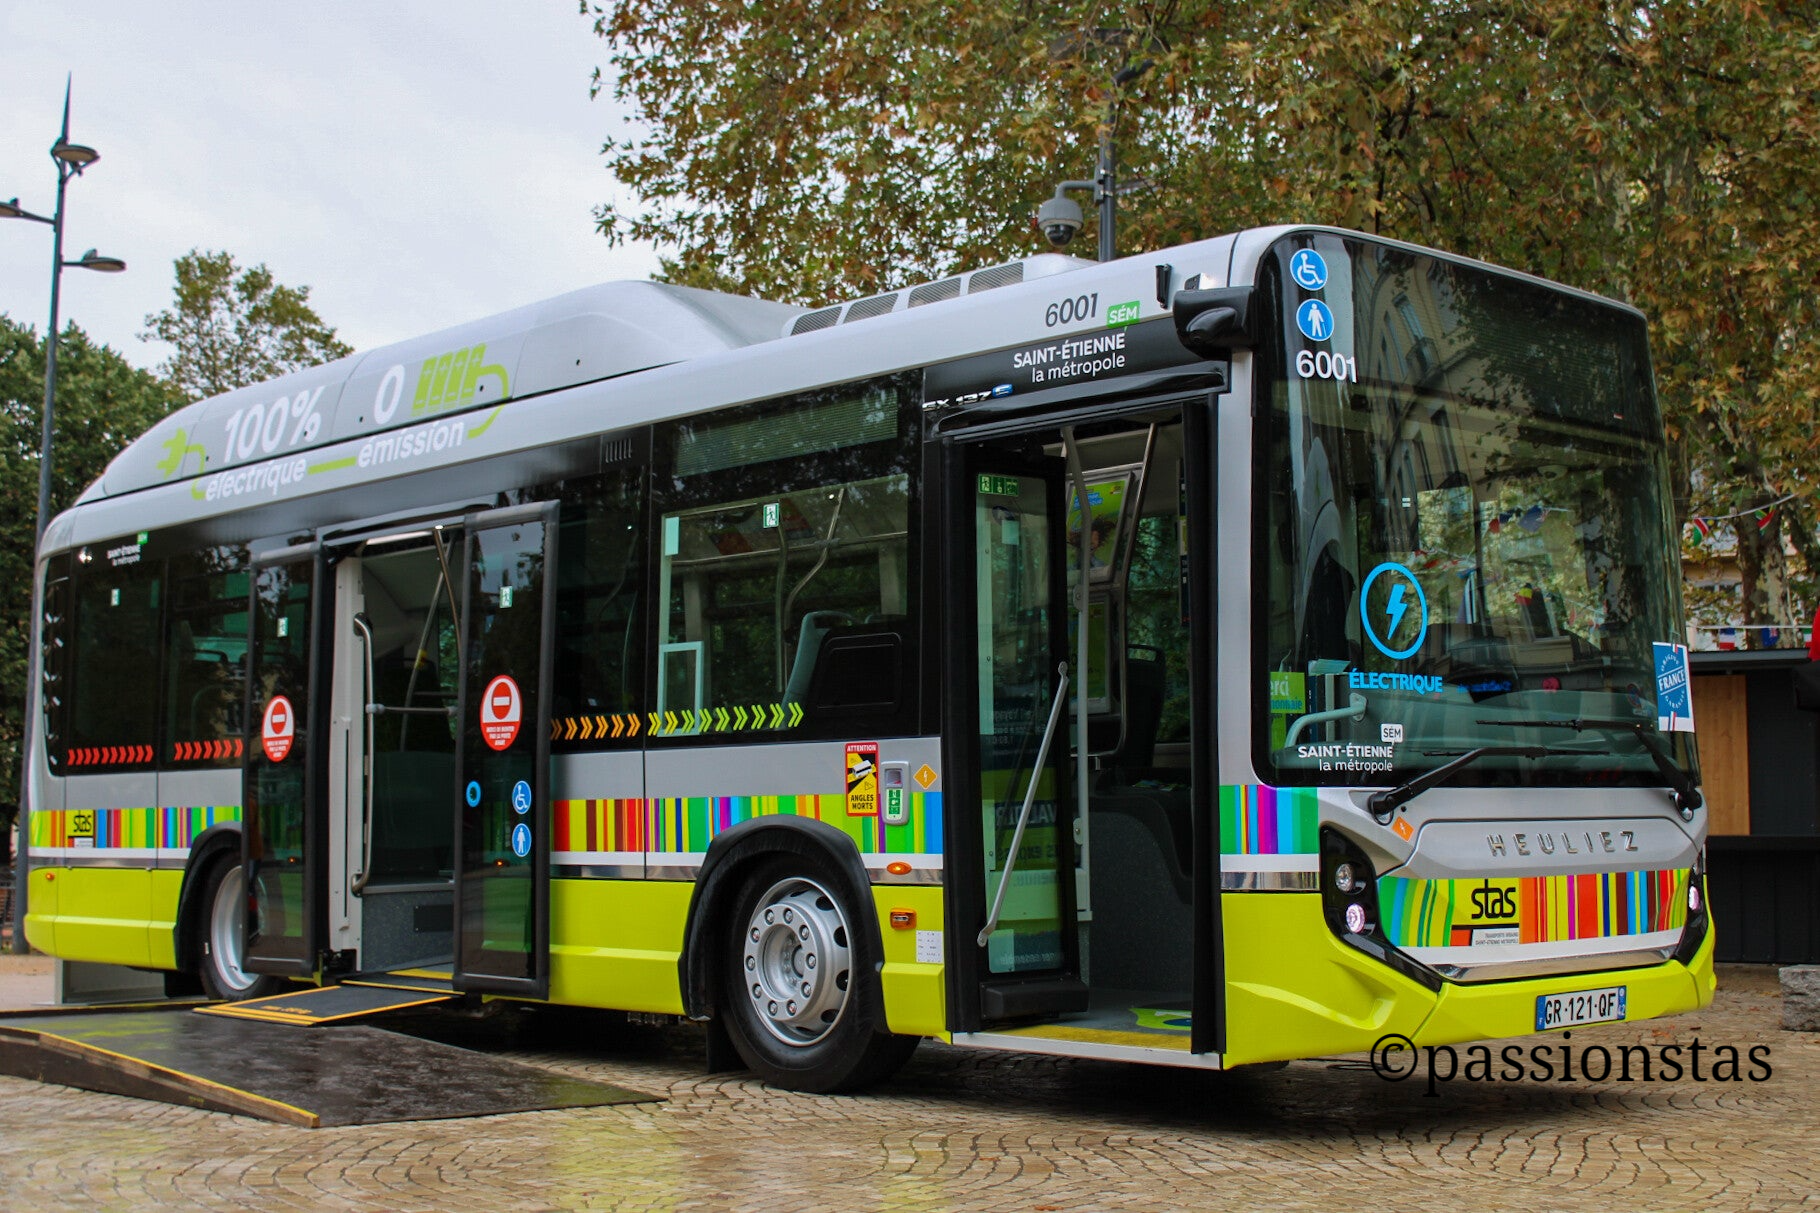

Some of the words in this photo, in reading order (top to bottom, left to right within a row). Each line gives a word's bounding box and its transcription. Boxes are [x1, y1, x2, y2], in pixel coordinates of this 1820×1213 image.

[1045, 292, 1098, 327] 6001
[1109, 304, 1138, 324] SÉM
[1013, 332, 1126, 369] SAINT-ÉTIENNE
[1031, 367, 1045, 383] la
[1047, 352, 1126, 380] métropole
[1295, 349, 1357, 383] 6001
[373, 363, 405, 425] 0
[956, 390, 992, 406] 137
[224, 386, 325, 463] 100%
[357, 420, 464, 469] émission
[205, 459, 307, 501] électrique
[1348, 667, 1443, 695] ÉLECTRIQUE
[1659, 669, 1685, 692] FRANCE
[1383, 727, 1401, 738] SÉM
[1298, 743, 1393, 758] SAINT-ÉTIENNE
[1319, 759, 1332, 772] la
[1335, 759, 1393, 774] métropole
[850, 794, 874, 802] ANGLES
[1487, 830, 1639, 857] HEULIEZ
[1471, 878, 1516, 919] stas
